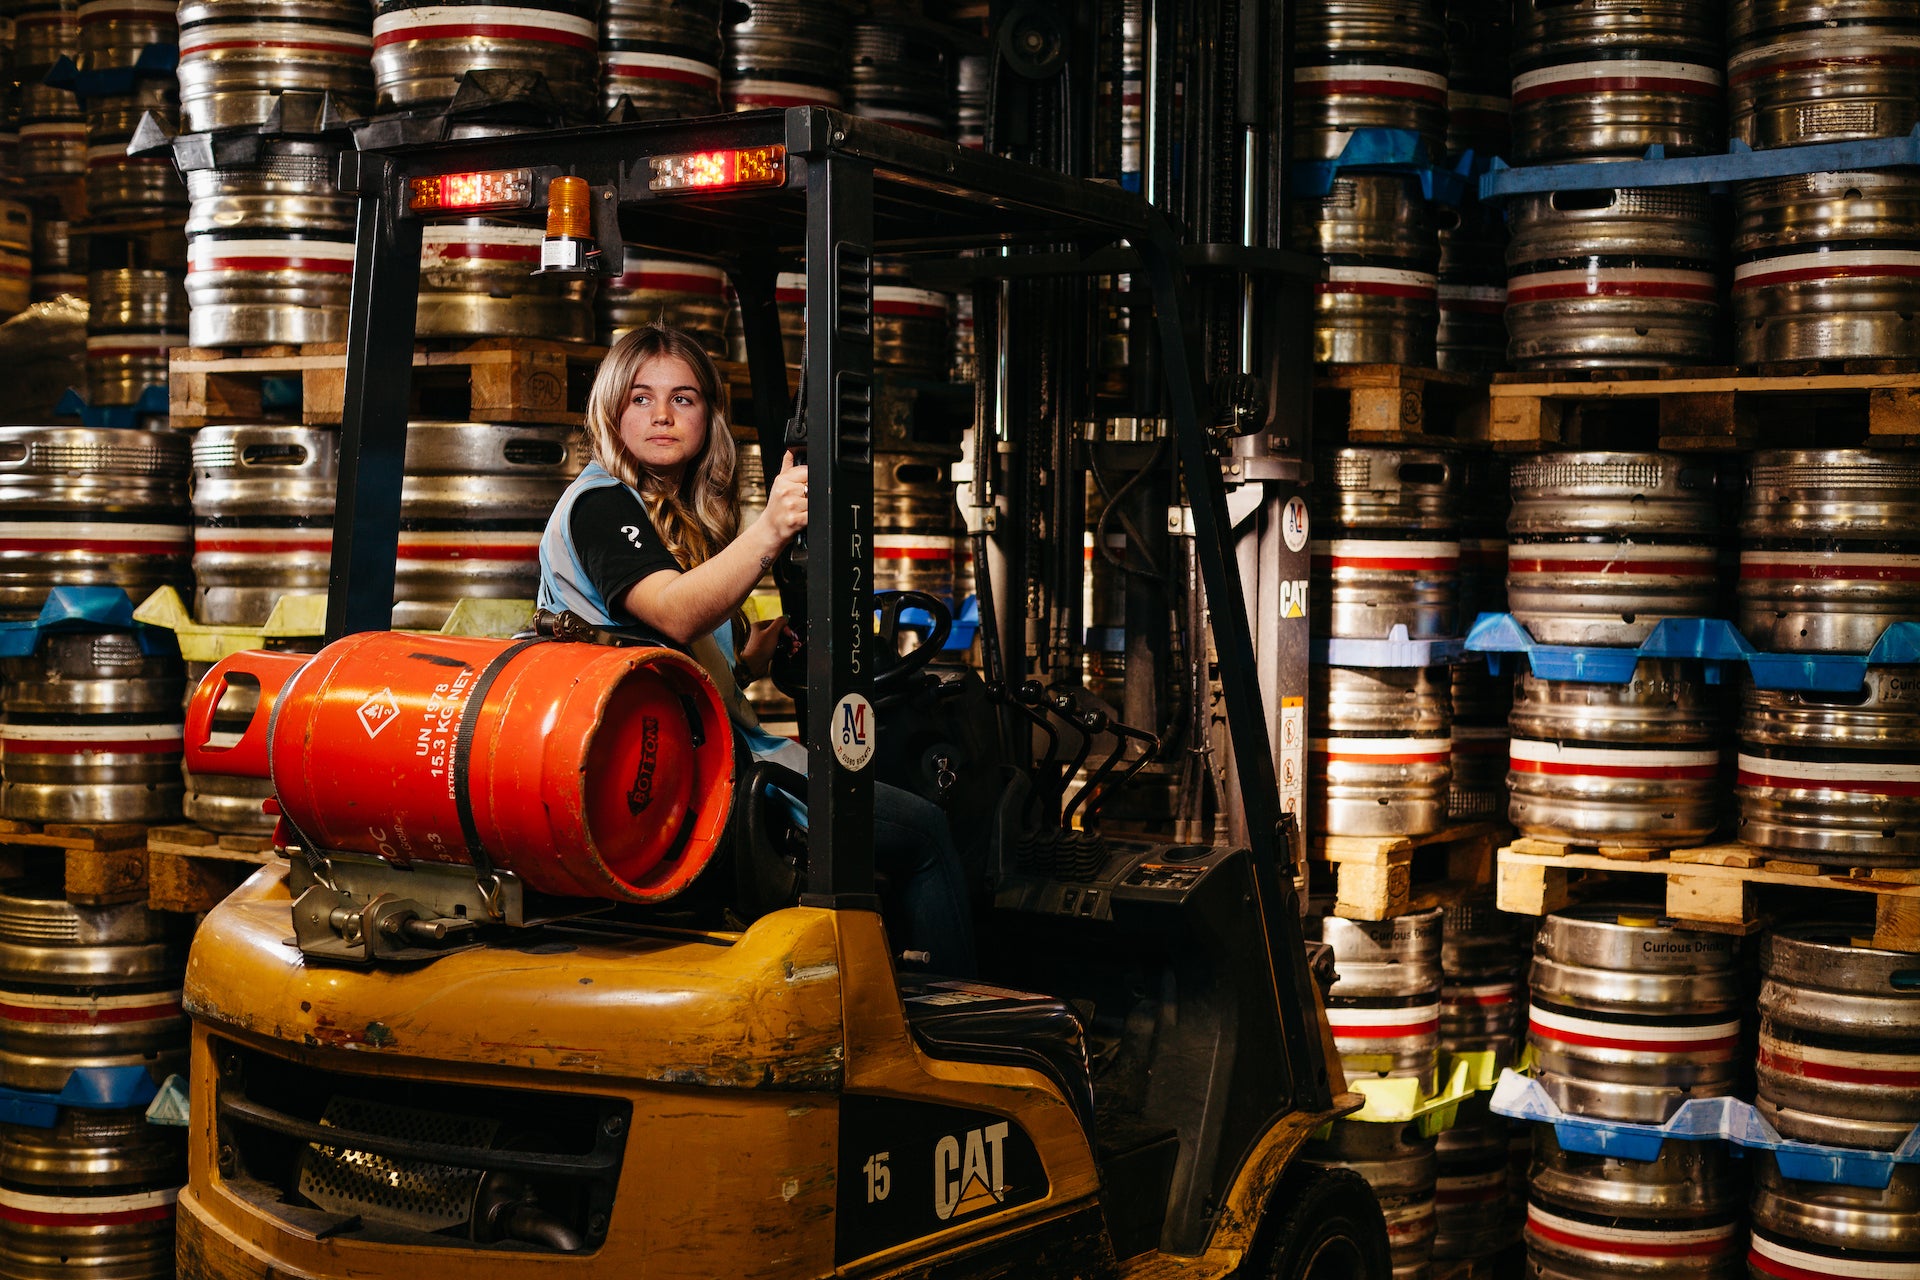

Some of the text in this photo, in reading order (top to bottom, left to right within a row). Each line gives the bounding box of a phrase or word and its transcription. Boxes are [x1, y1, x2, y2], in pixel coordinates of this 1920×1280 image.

[531, 378, 557, 400] EPAL
[850, 504, 862, 674] TR2435
[1280, 579, 1309, 619] CAT
[415, 683, 449, 756] UN 1978
[431, 669, 473, 778] 15.3 KG NET
[633, 717, 658, 804] BOTTOM
[1369, 929, 1412, 942] Curious
[1642, 941, 1692, 953] Curious
[862, 1120, 1009, 1221] 15 CAT
